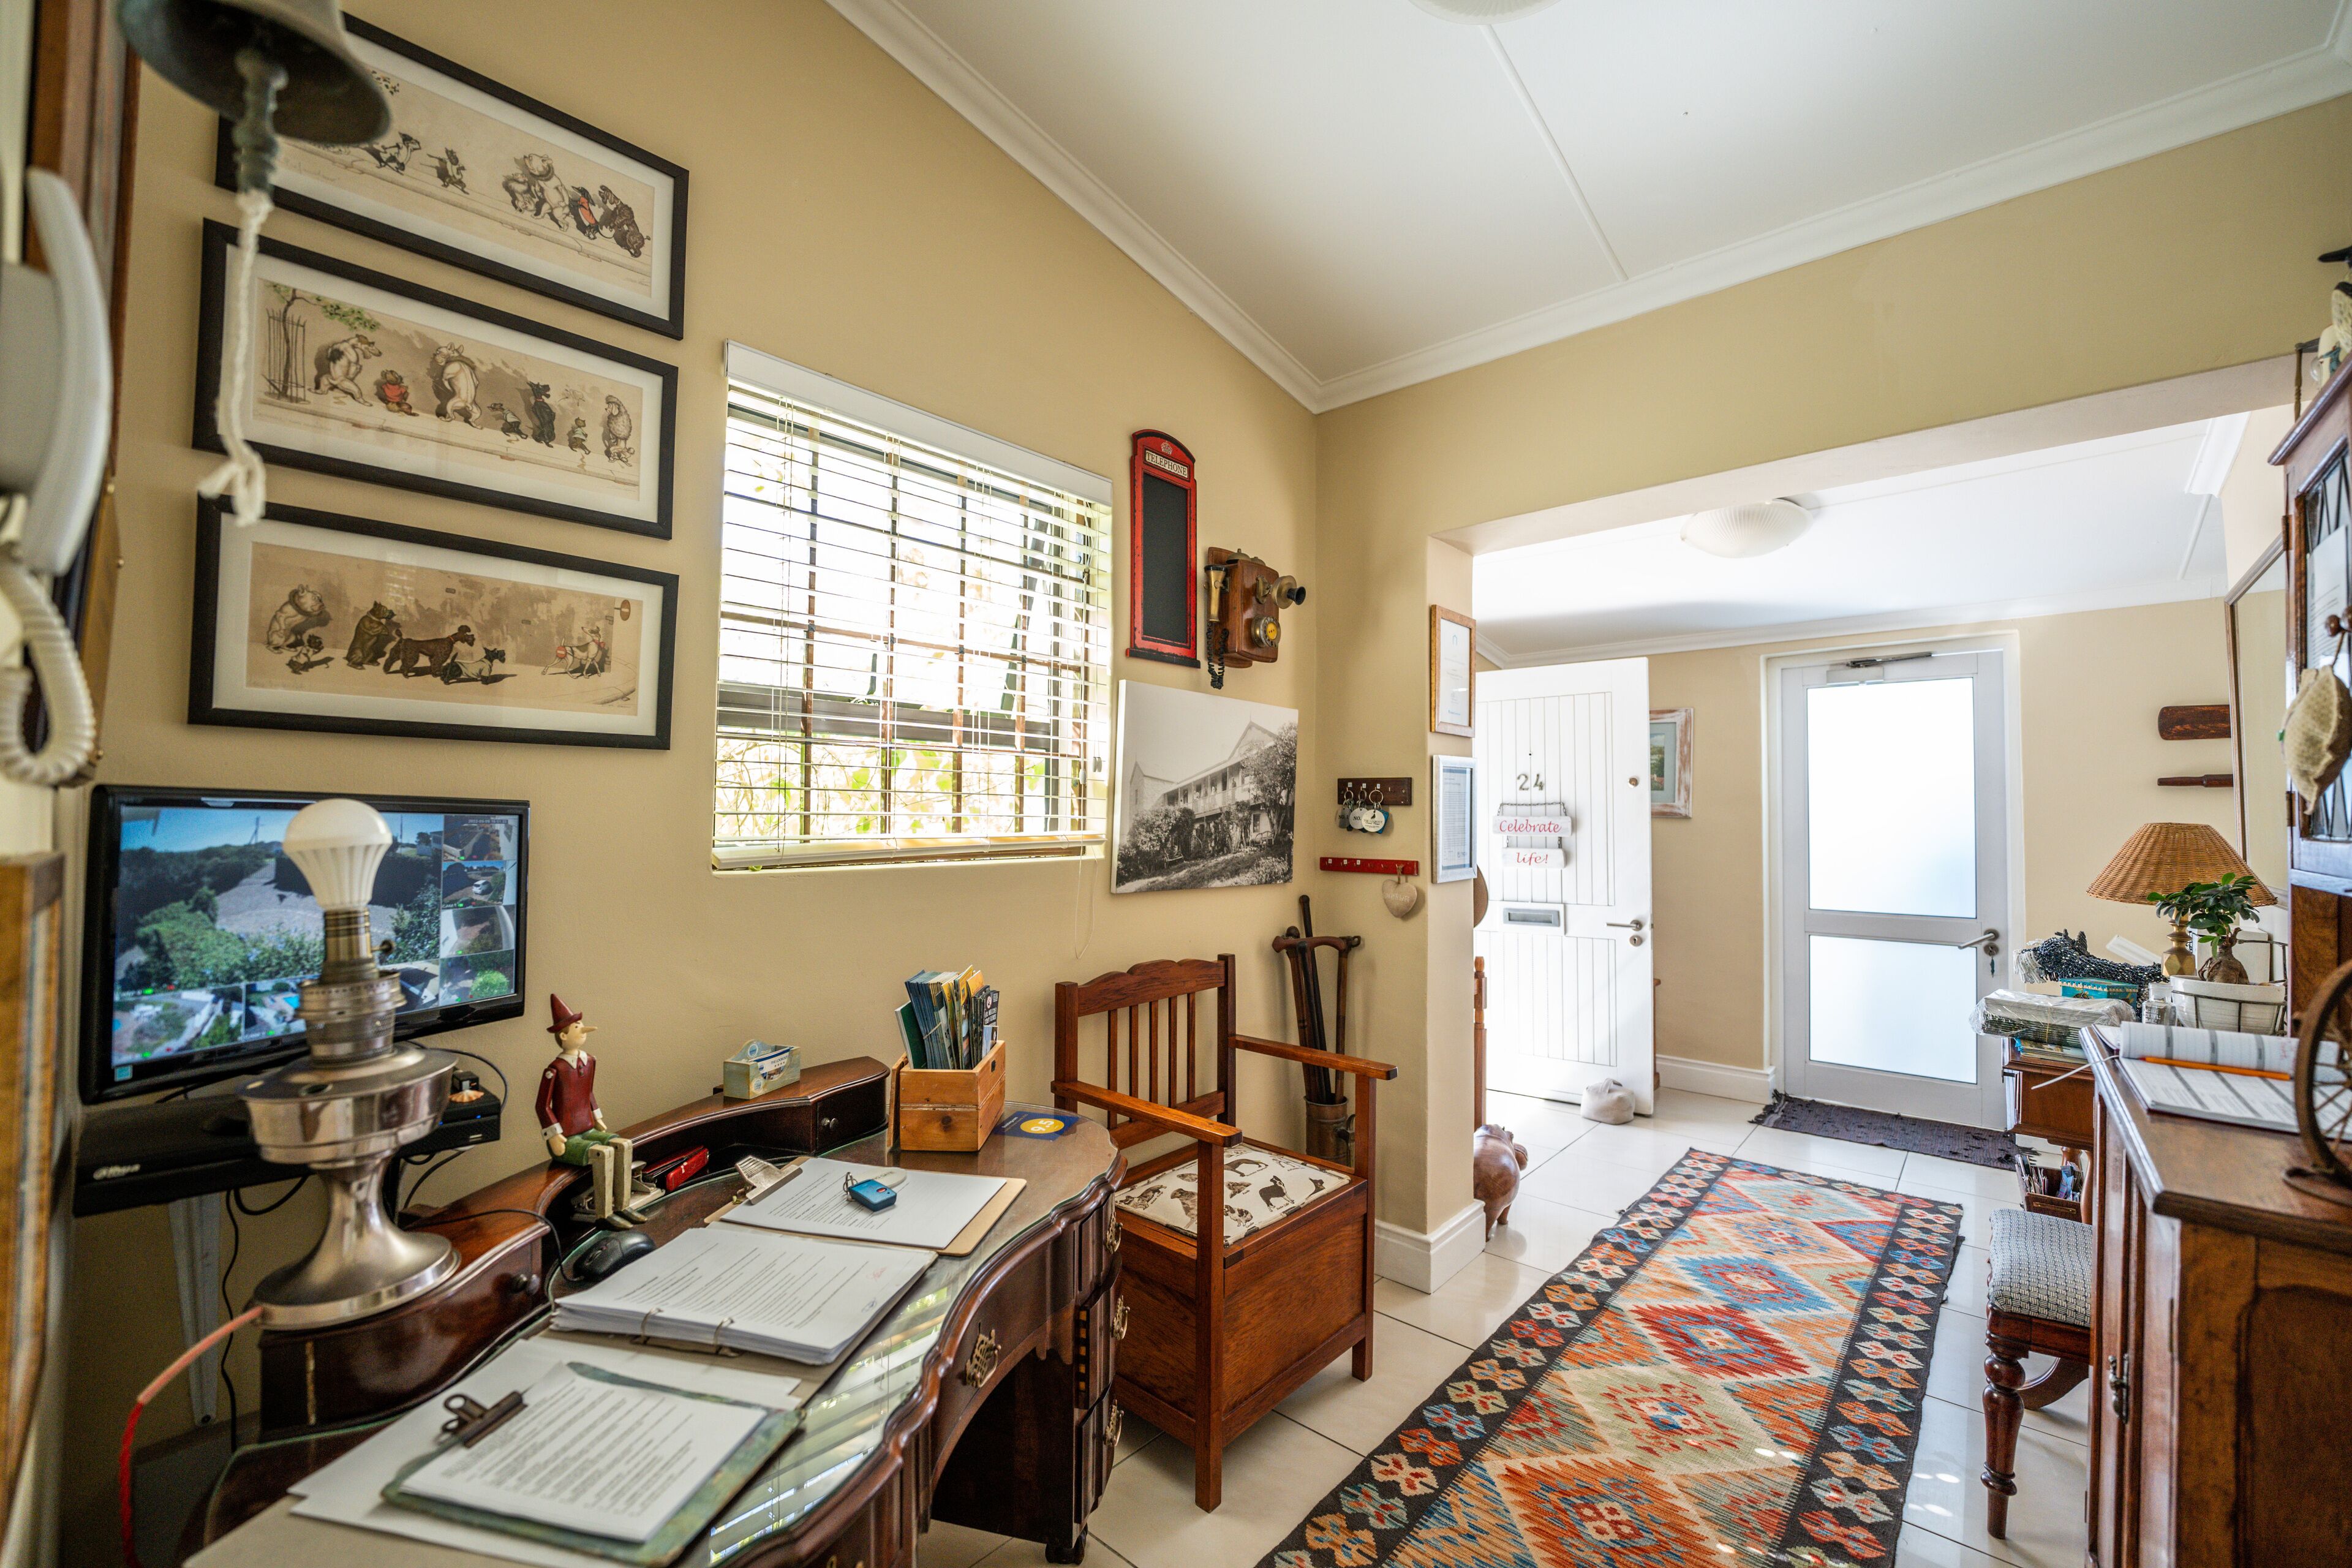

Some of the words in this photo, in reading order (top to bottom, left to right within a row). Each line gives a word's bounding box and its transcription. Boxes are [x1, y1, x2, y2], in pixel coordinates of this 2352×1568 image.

[1146, 452, 1187, 477] TELEPHONE
[1517, 774, 1545, 791] 24
[1499, 818, 1562, 833] Celebrate
[1516, 852, 1548, 866] life!
[1030, 1120, 1054, 1131] 9.5
